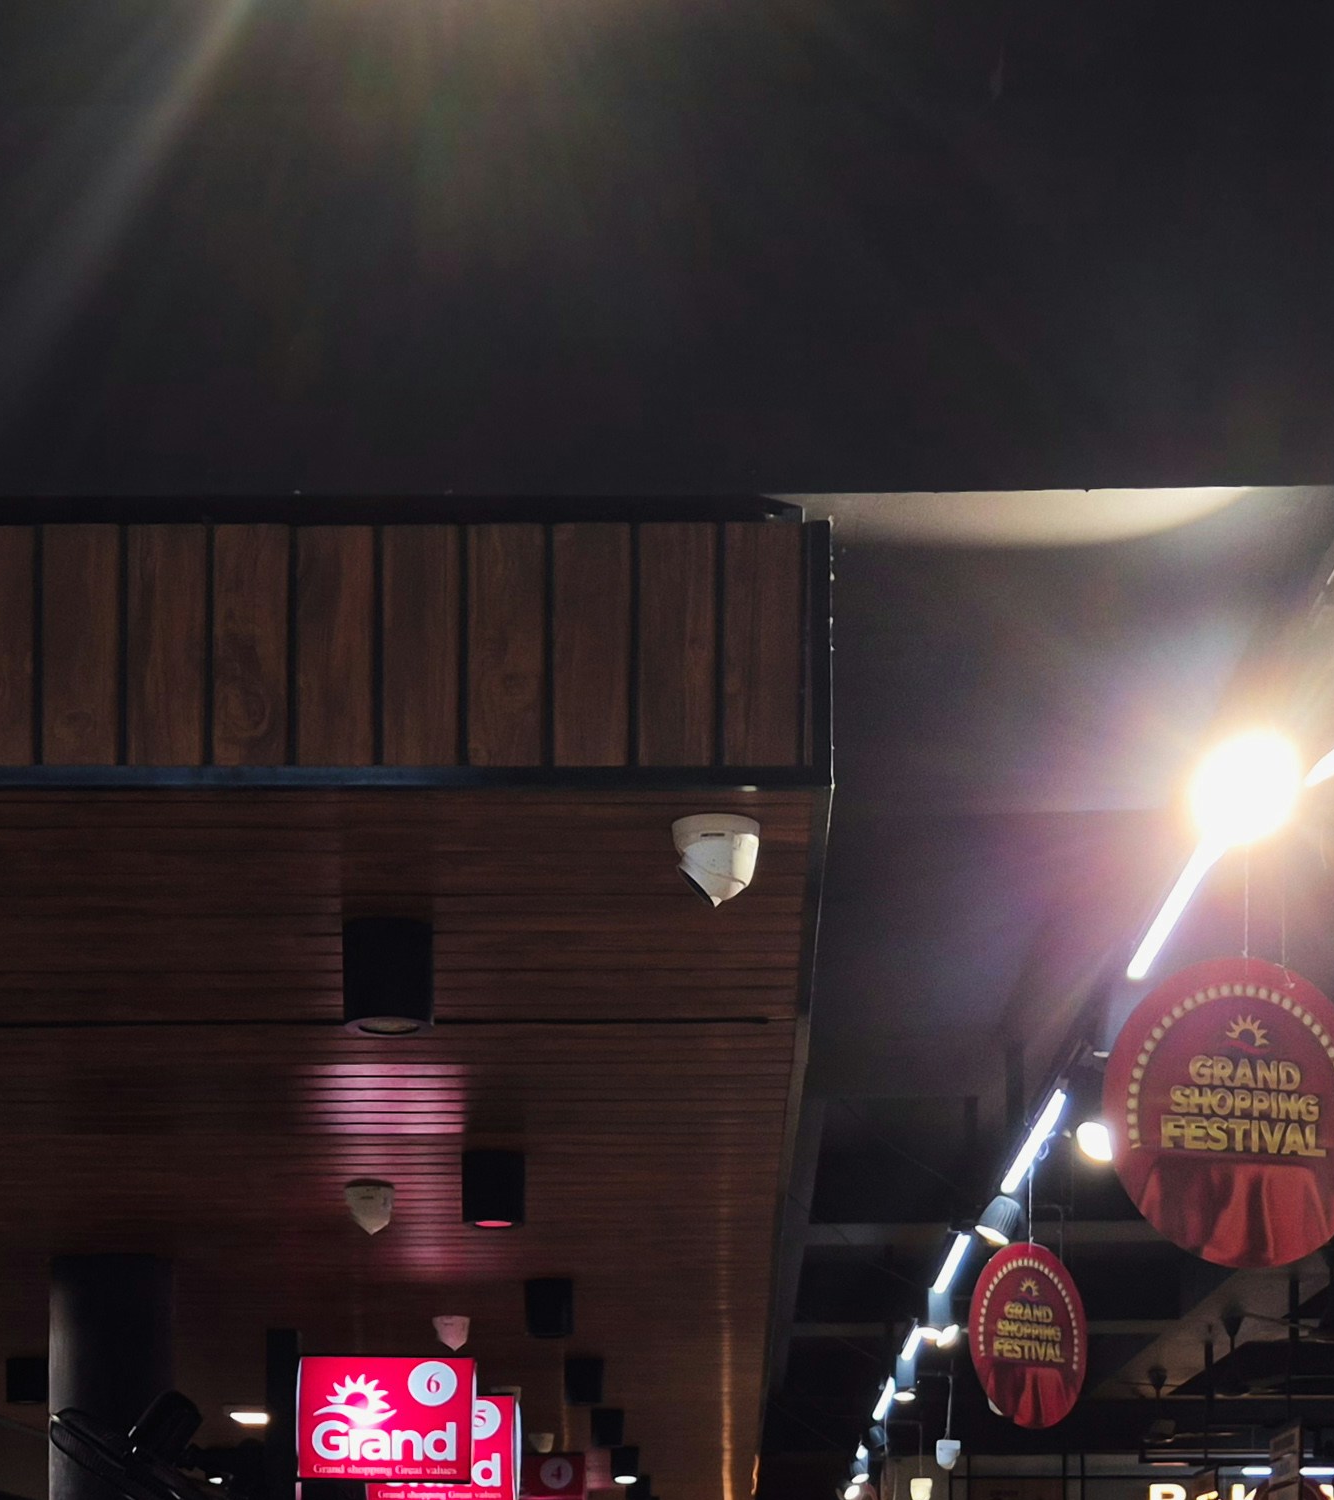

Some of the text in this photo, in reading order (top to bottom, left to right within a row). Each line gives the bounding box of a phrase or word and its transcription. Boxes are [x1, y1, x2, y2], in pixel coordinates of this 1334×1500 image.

[1188, 1055, 1302, 1091] GRAND
[1170, 1084, 1320, 1122] SHOPPING
[1160, 1114, 1327, 1157] FESTIVAL
[1003, 1300, 1054, 1324] GRAND
[996, 1317, 1062, 1342] SHOPPING
[993, 1335, 1066, 1363] FESTIVAL
[426, 1371, 441, 1394] 6
[473, 1408, 487, 1428] 5
[311, 1419, 458, 1462] Grand
[313, 1463, 458, 1477] Grand shopping Great values
